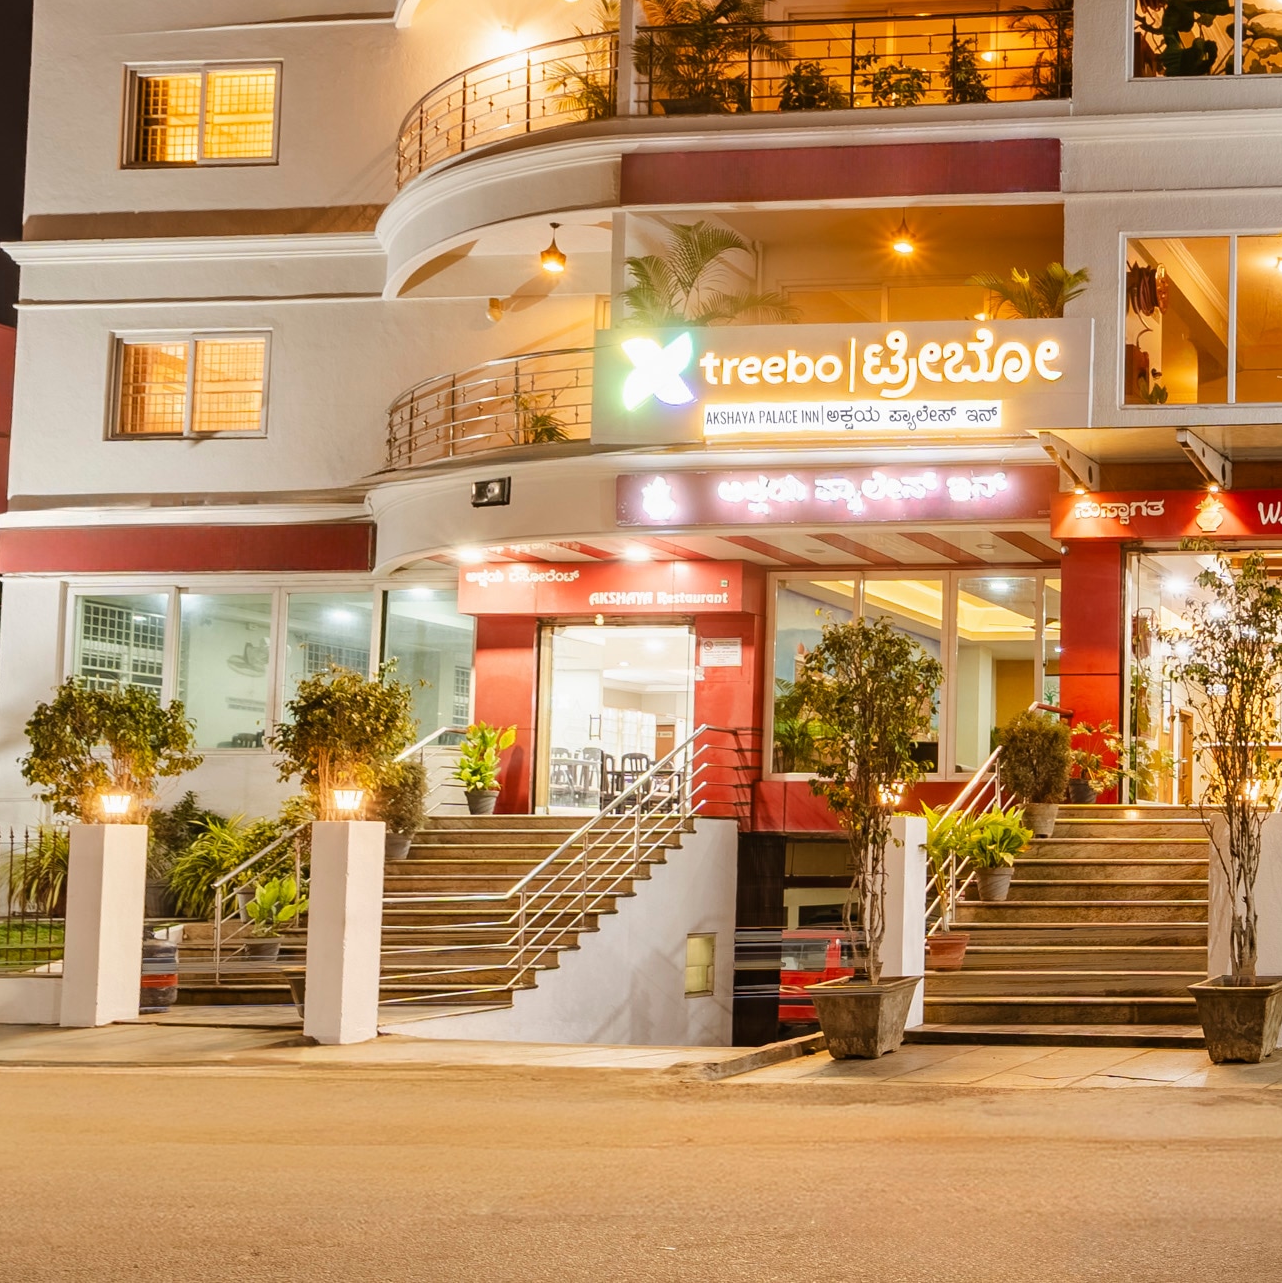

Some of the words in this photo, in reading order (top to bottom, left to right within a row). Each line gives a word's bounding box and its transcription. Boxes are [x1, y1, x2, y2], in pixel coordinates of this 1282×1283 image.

[699, 349, 843, 386] treebo
[863, 328, 1063, 399] ಟ್ರೀಬೋ
[706, 410, 756, 426] AKSHAYA
[759, 409, 798, 424] PALACE
[801, 409, 820, 423] INN
[965, 405, 998, 422] ಇನ್
[589, 591, 653, 606] AKSHAYA
[657, 591, 729, 605] Restaurant
